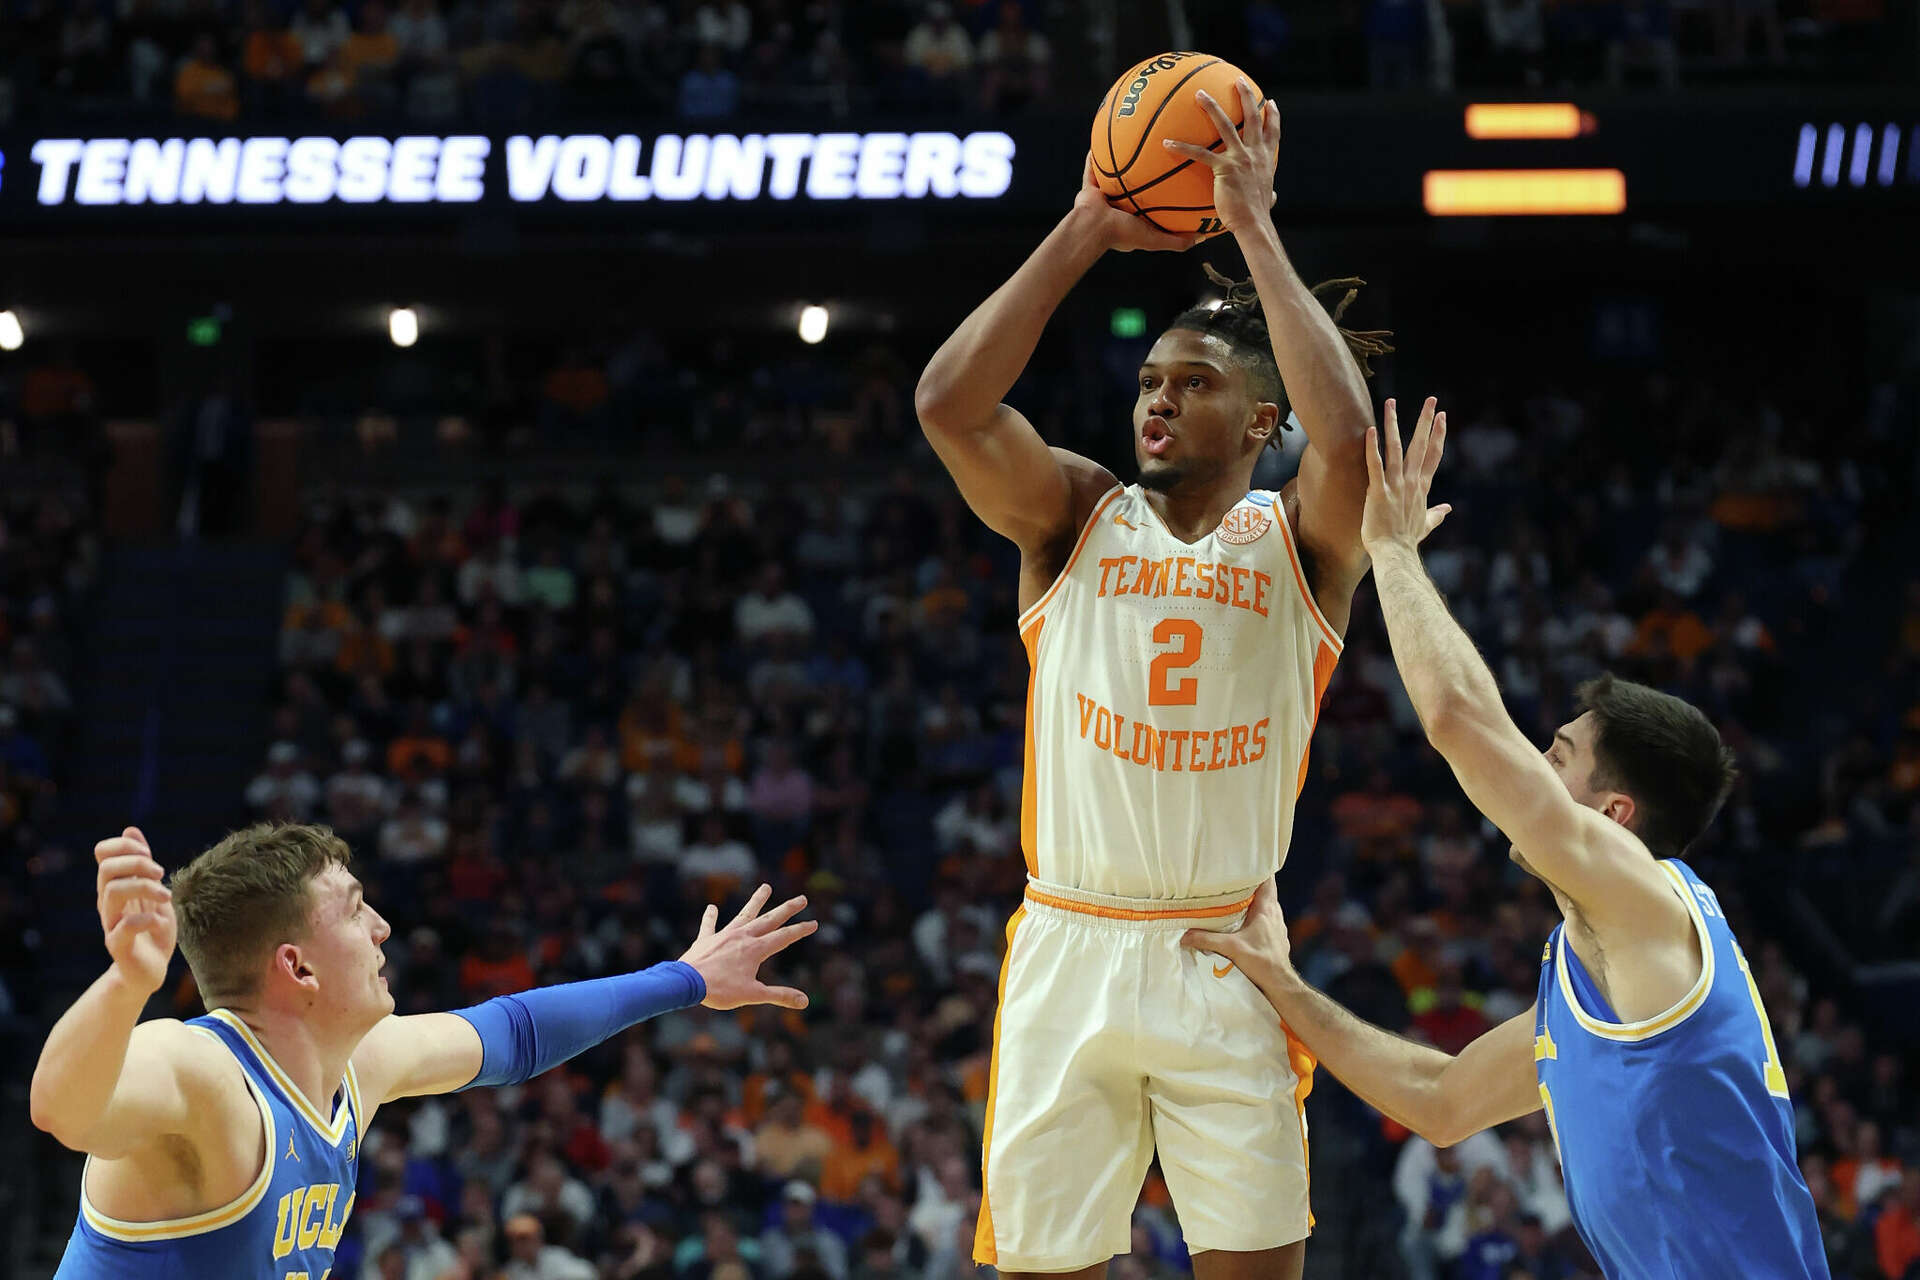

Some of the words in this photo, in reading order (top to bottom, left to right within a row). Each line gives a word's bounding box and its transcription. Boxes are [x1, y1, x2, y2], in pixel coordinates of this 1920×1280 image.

[31, 136, 490, 205] TENNESSEE
[506, 132, 1015, 201] VOLUNTEERS
[1225, 508, 1262, 533] SEC
[1097, 555, 1272, 617] TENNESSEE
[1148, 618, 1203, 706] 2
[1077, 692, 1270, 772] VOLUNTEERS
